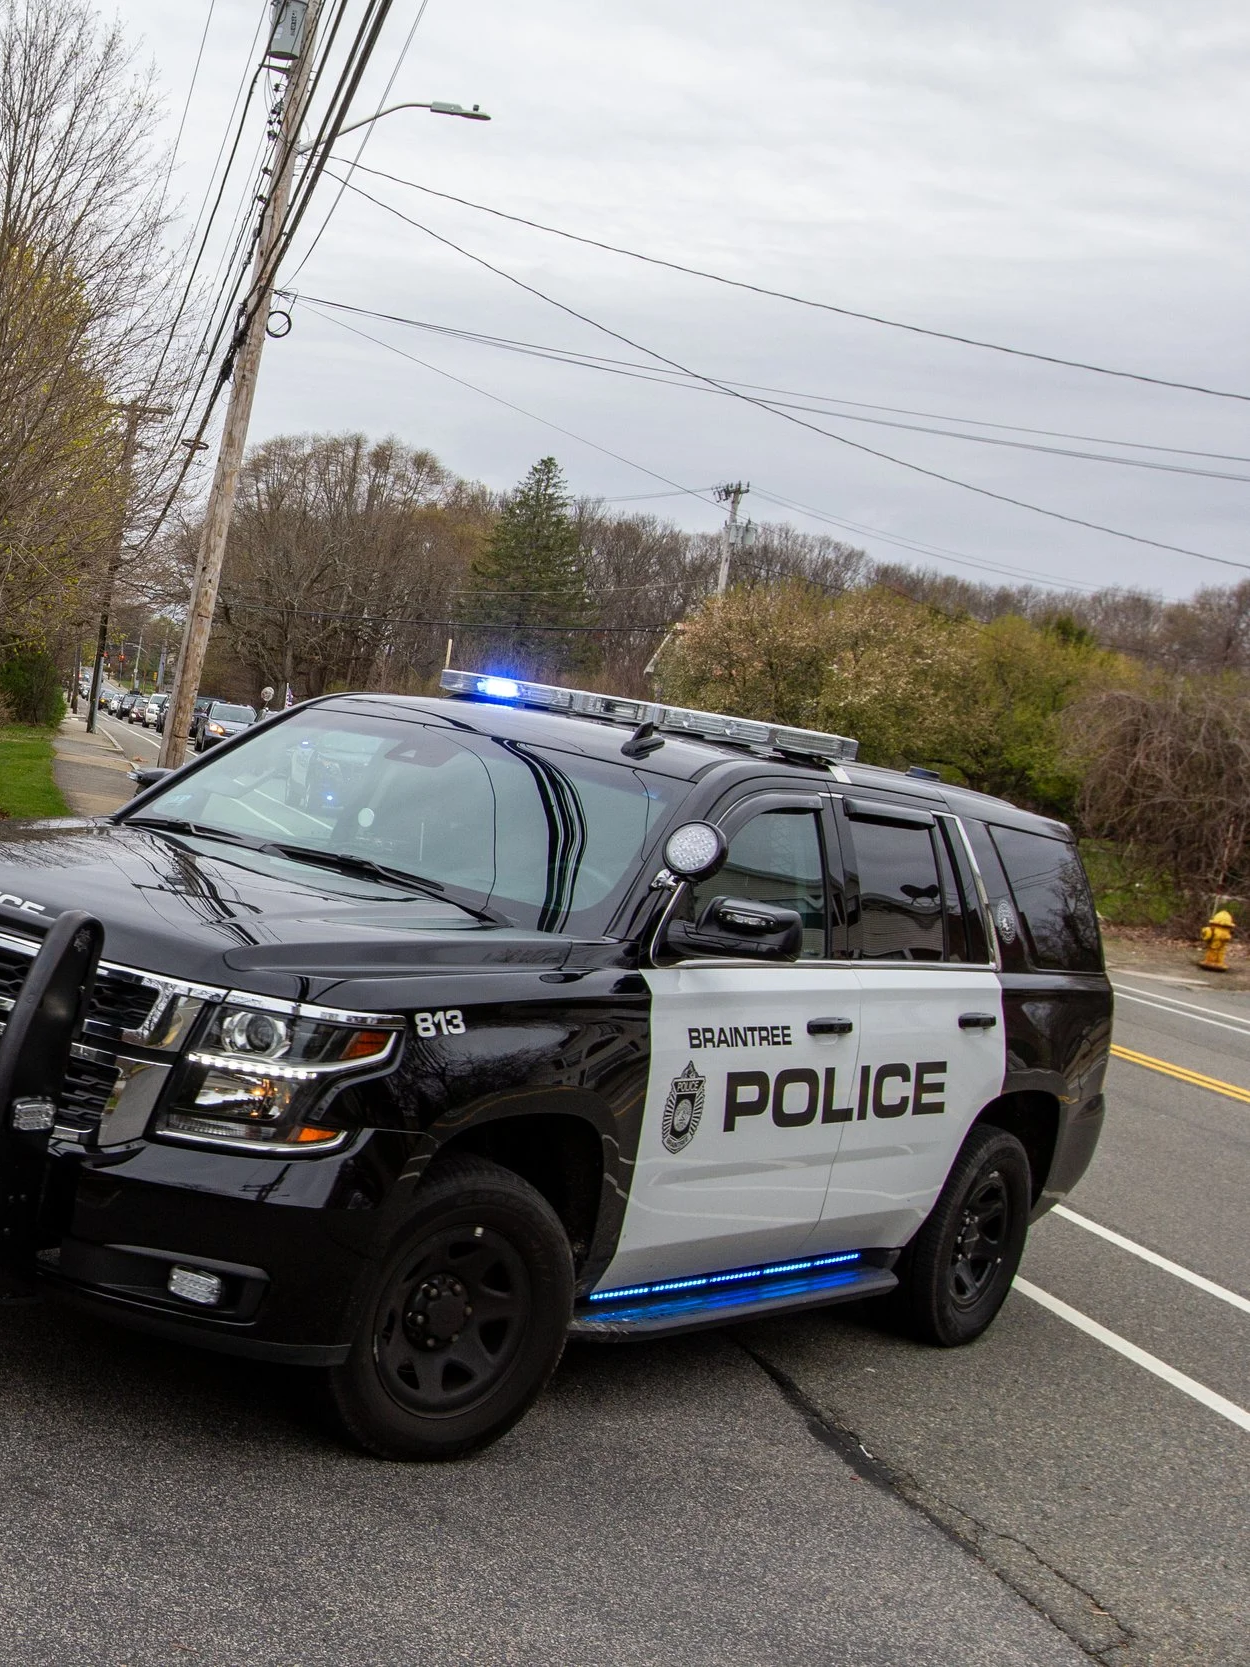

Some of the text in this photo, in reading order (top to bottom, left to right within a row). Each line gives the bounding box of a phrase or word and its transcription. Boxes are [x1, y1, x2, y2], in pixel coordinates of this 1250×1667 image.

[414, 1009, 466, 1038] 813
[687, 1025, 792, 1049] BRAINTREE
[677, 1081, 699, 1091] POLICE
[723, 1060, 948, 1132] POLICE
